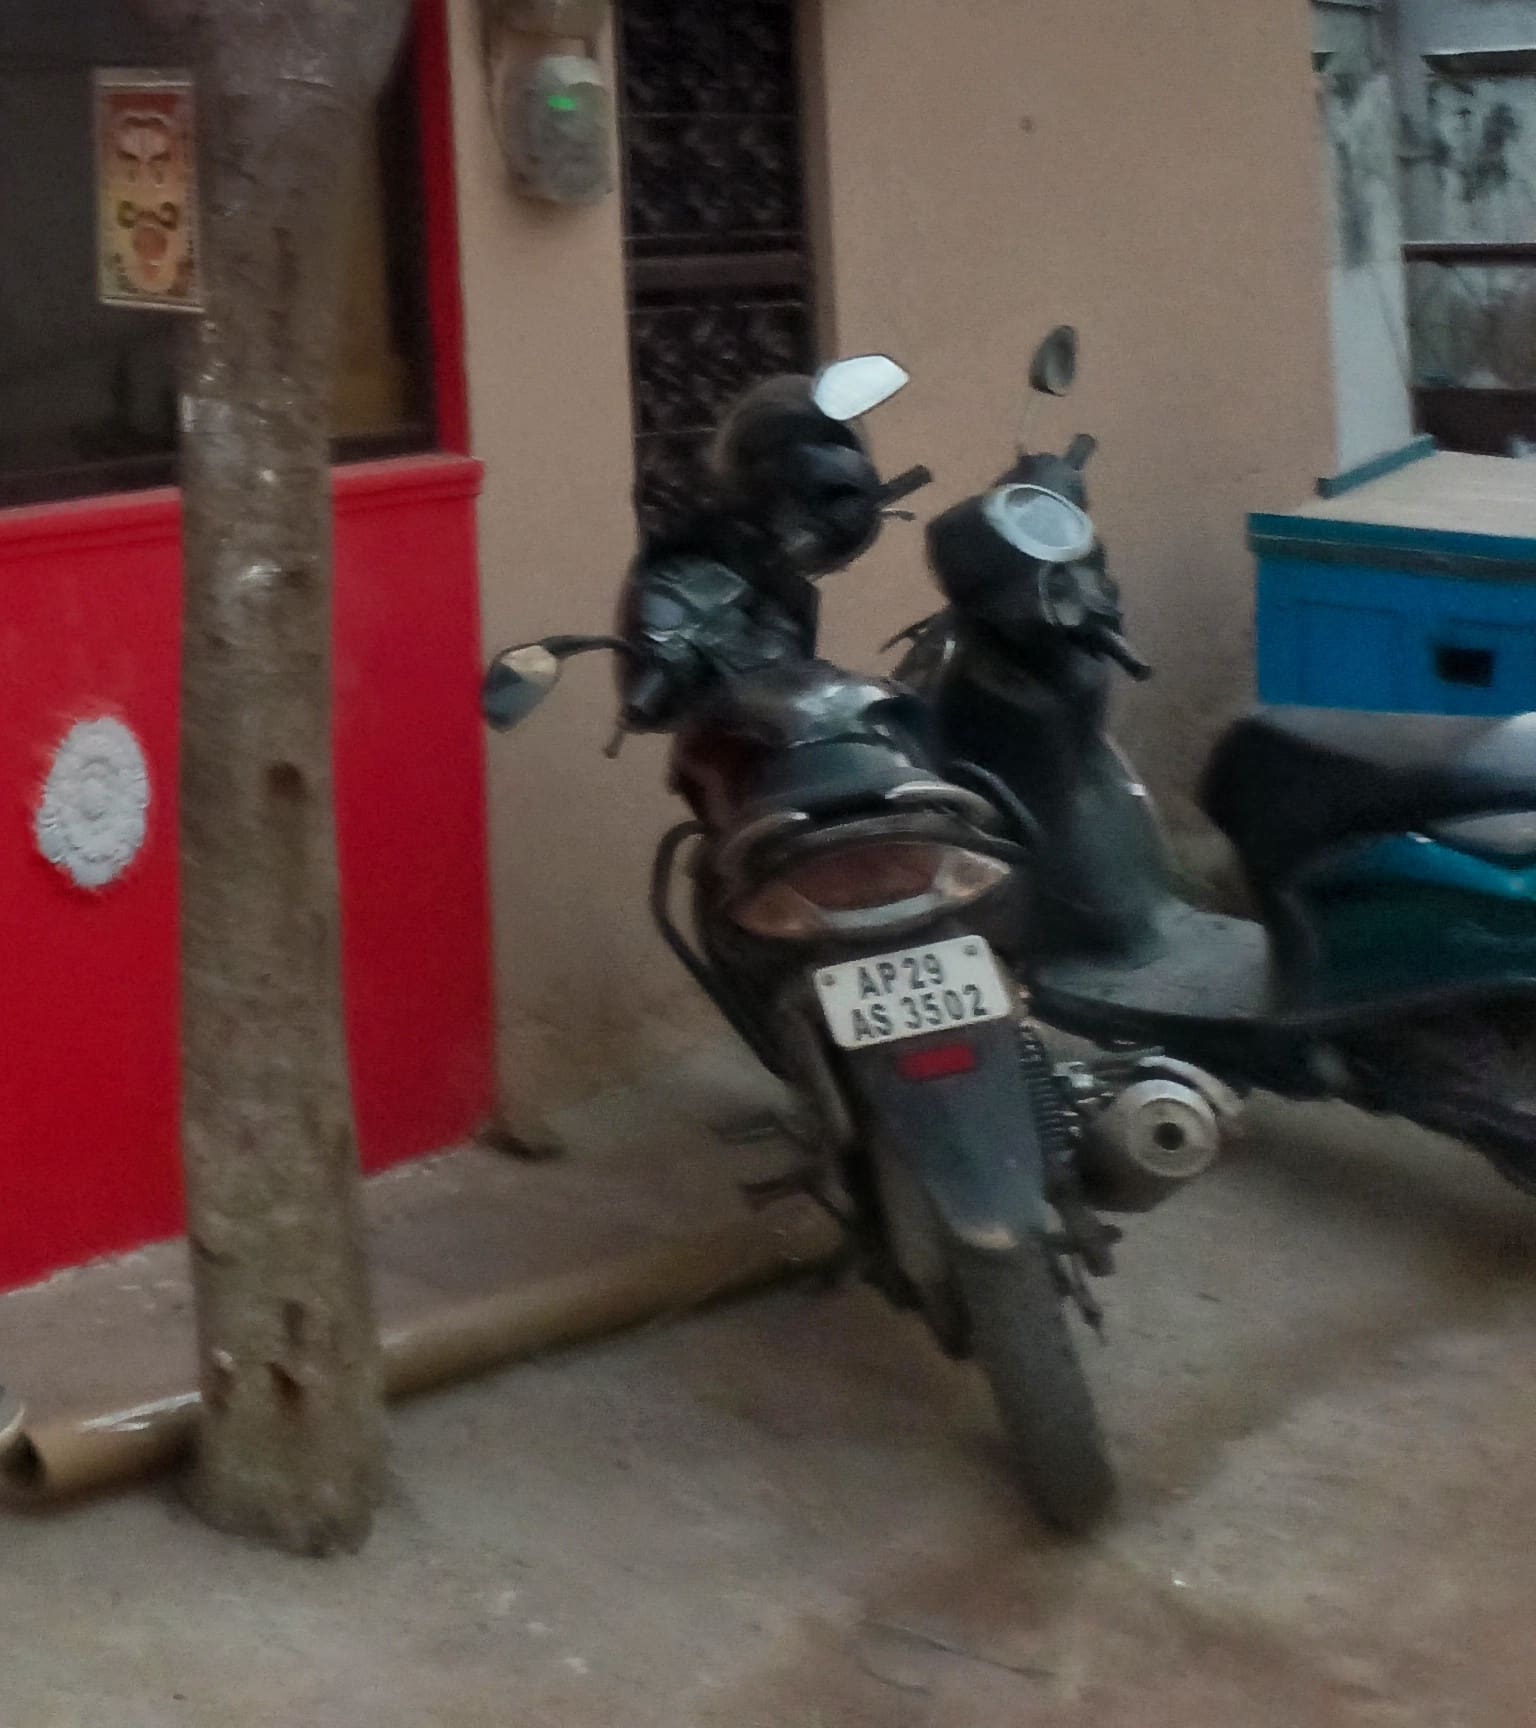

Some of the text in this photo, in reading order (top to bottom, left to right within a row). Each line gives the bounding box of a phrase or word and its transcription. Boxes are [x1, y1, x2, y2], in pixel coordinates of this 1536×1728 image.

[856, 961, 896, 999] AP
[852, 983, 987, 1040] AS 3502
